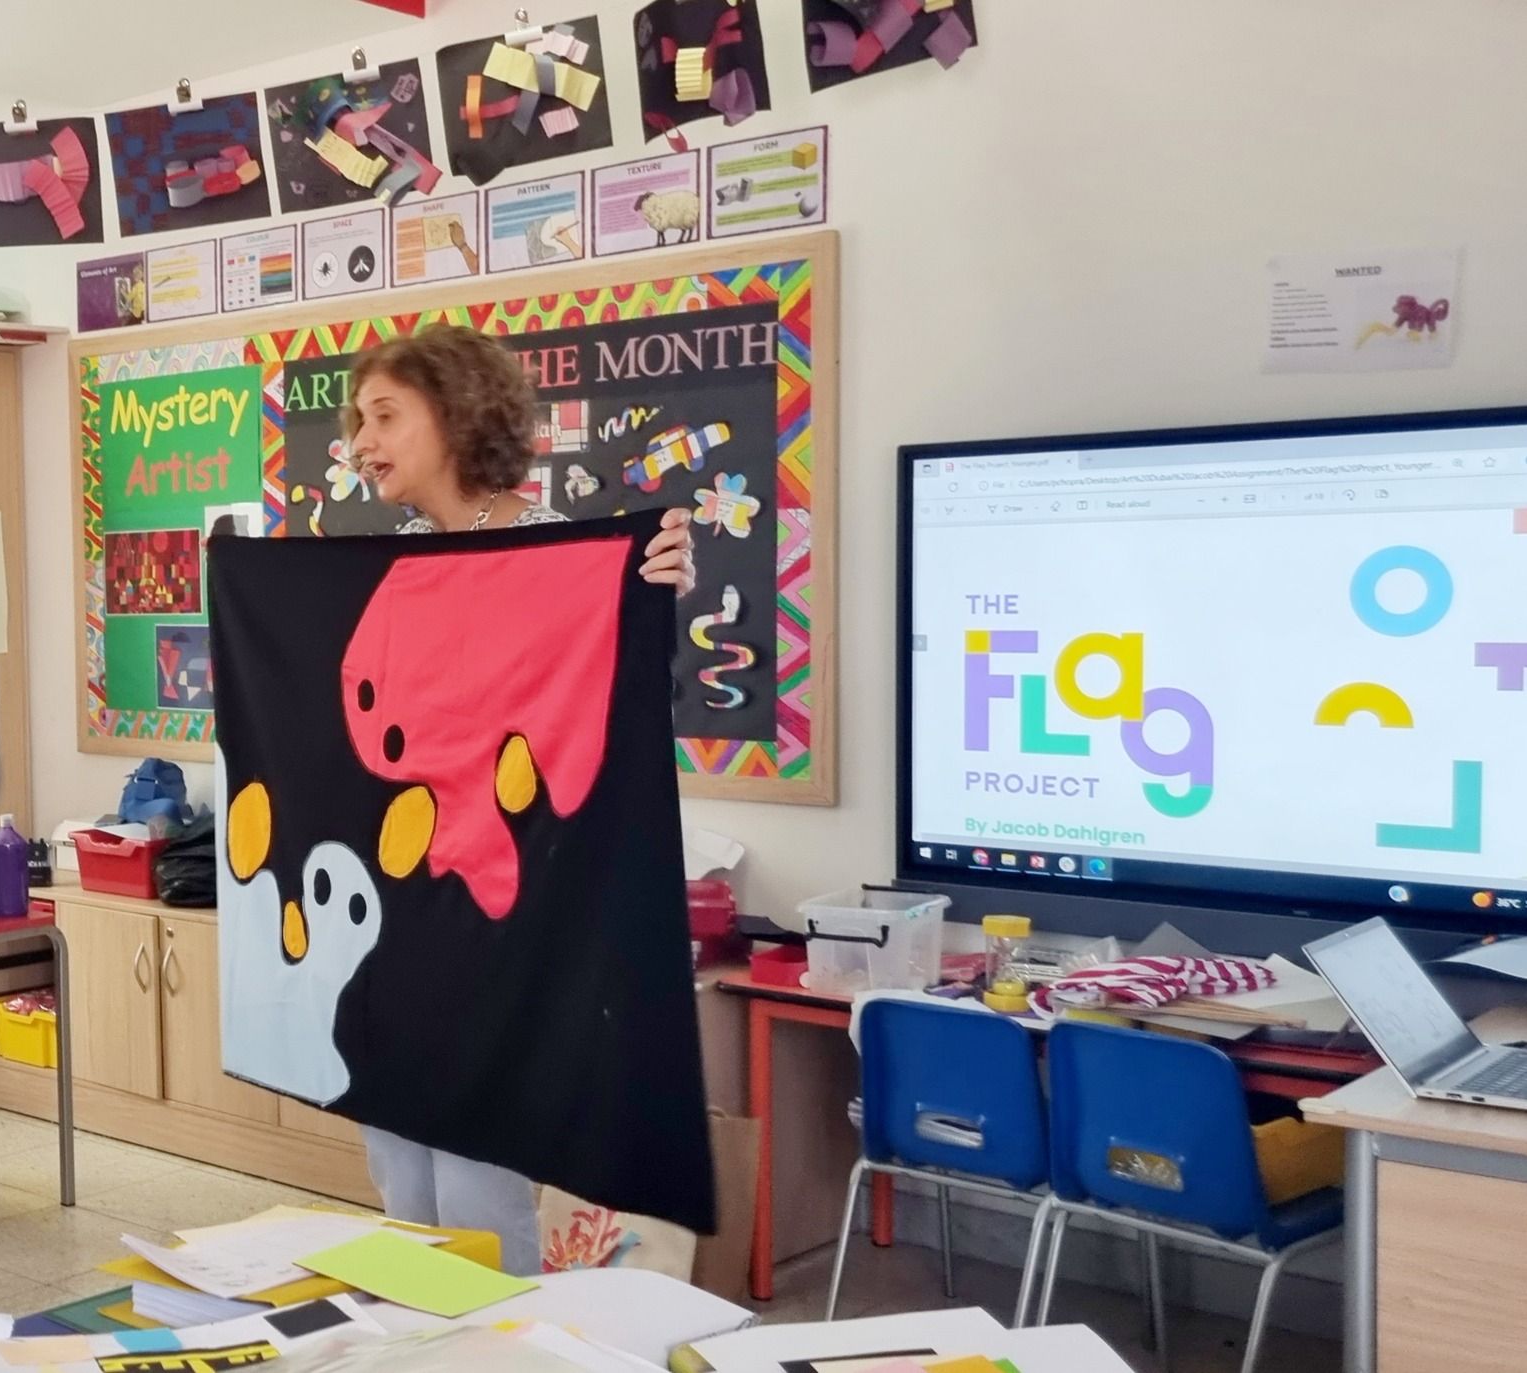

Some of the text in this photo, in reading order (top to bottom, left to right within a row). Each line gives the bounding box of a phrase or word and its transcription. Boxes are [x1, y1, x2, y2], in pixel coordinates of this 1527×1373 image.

[754, 140, 778, 152] FORM
[627, 162, 662, 175] TEXTURE
[516, 183, 551, 196] PATTERN
[333, 219, 352, 229] SPACE
[1335, 265, 1382, 277] WANTED
[283, 369, 352, 412] ART
[594, 321, 778, 383] MONTH
[110, 384, 249, 448] Mystery
[125, 447, 232, 496] Artist
[1127, 500, 1151, 508] aloud
[965, 594, 1019, 615] THE
[965, 771, 1100, 799] PROJECT
[965, 817, 1146, 846] By Jacob Dahlgren
